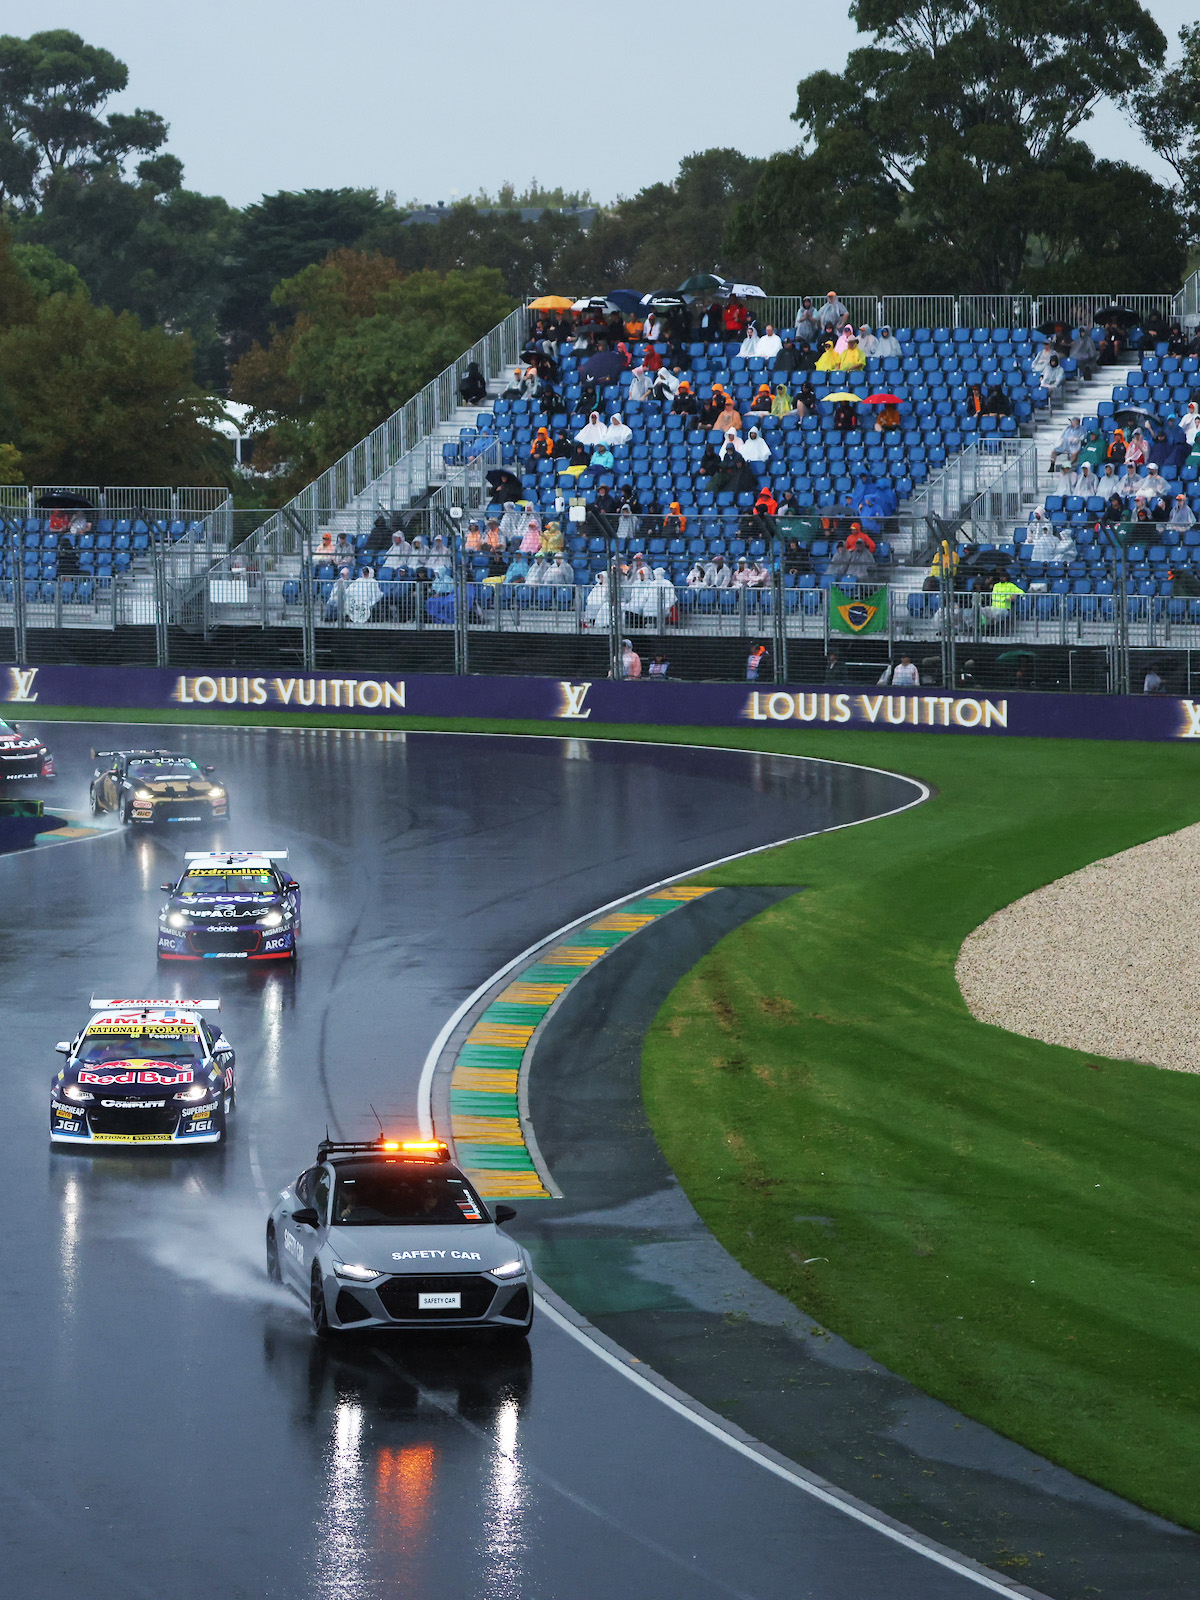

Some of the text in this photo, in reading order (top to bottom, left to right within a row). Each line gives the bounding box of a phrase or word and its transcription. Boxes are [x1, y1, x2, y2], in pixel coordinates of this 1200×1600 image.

[180, 675, 406, 708] LOUIS VUITTON
[753, 691, 1007, 728] LOUIS VUITTON
[188, 868, 270, 876] Hydraulink
[78, 1070, 194, 1085] Red Bull
[51, 1099, 85, 1116] SUPERCHEAP
[100, 1099, 166, 1108] COMPLETE
[181, 1100, 219, 1117] SUPERCHEAP
[55, 1119, 80, 1132] JGI
[185, 1120, 212, 1133] JGI
[284, 1228, 297, 1258] SAFETY
[391, 1249, 482, 1262] SAFETY CAR
[424, 1297, 444, 1305] SAFETY
